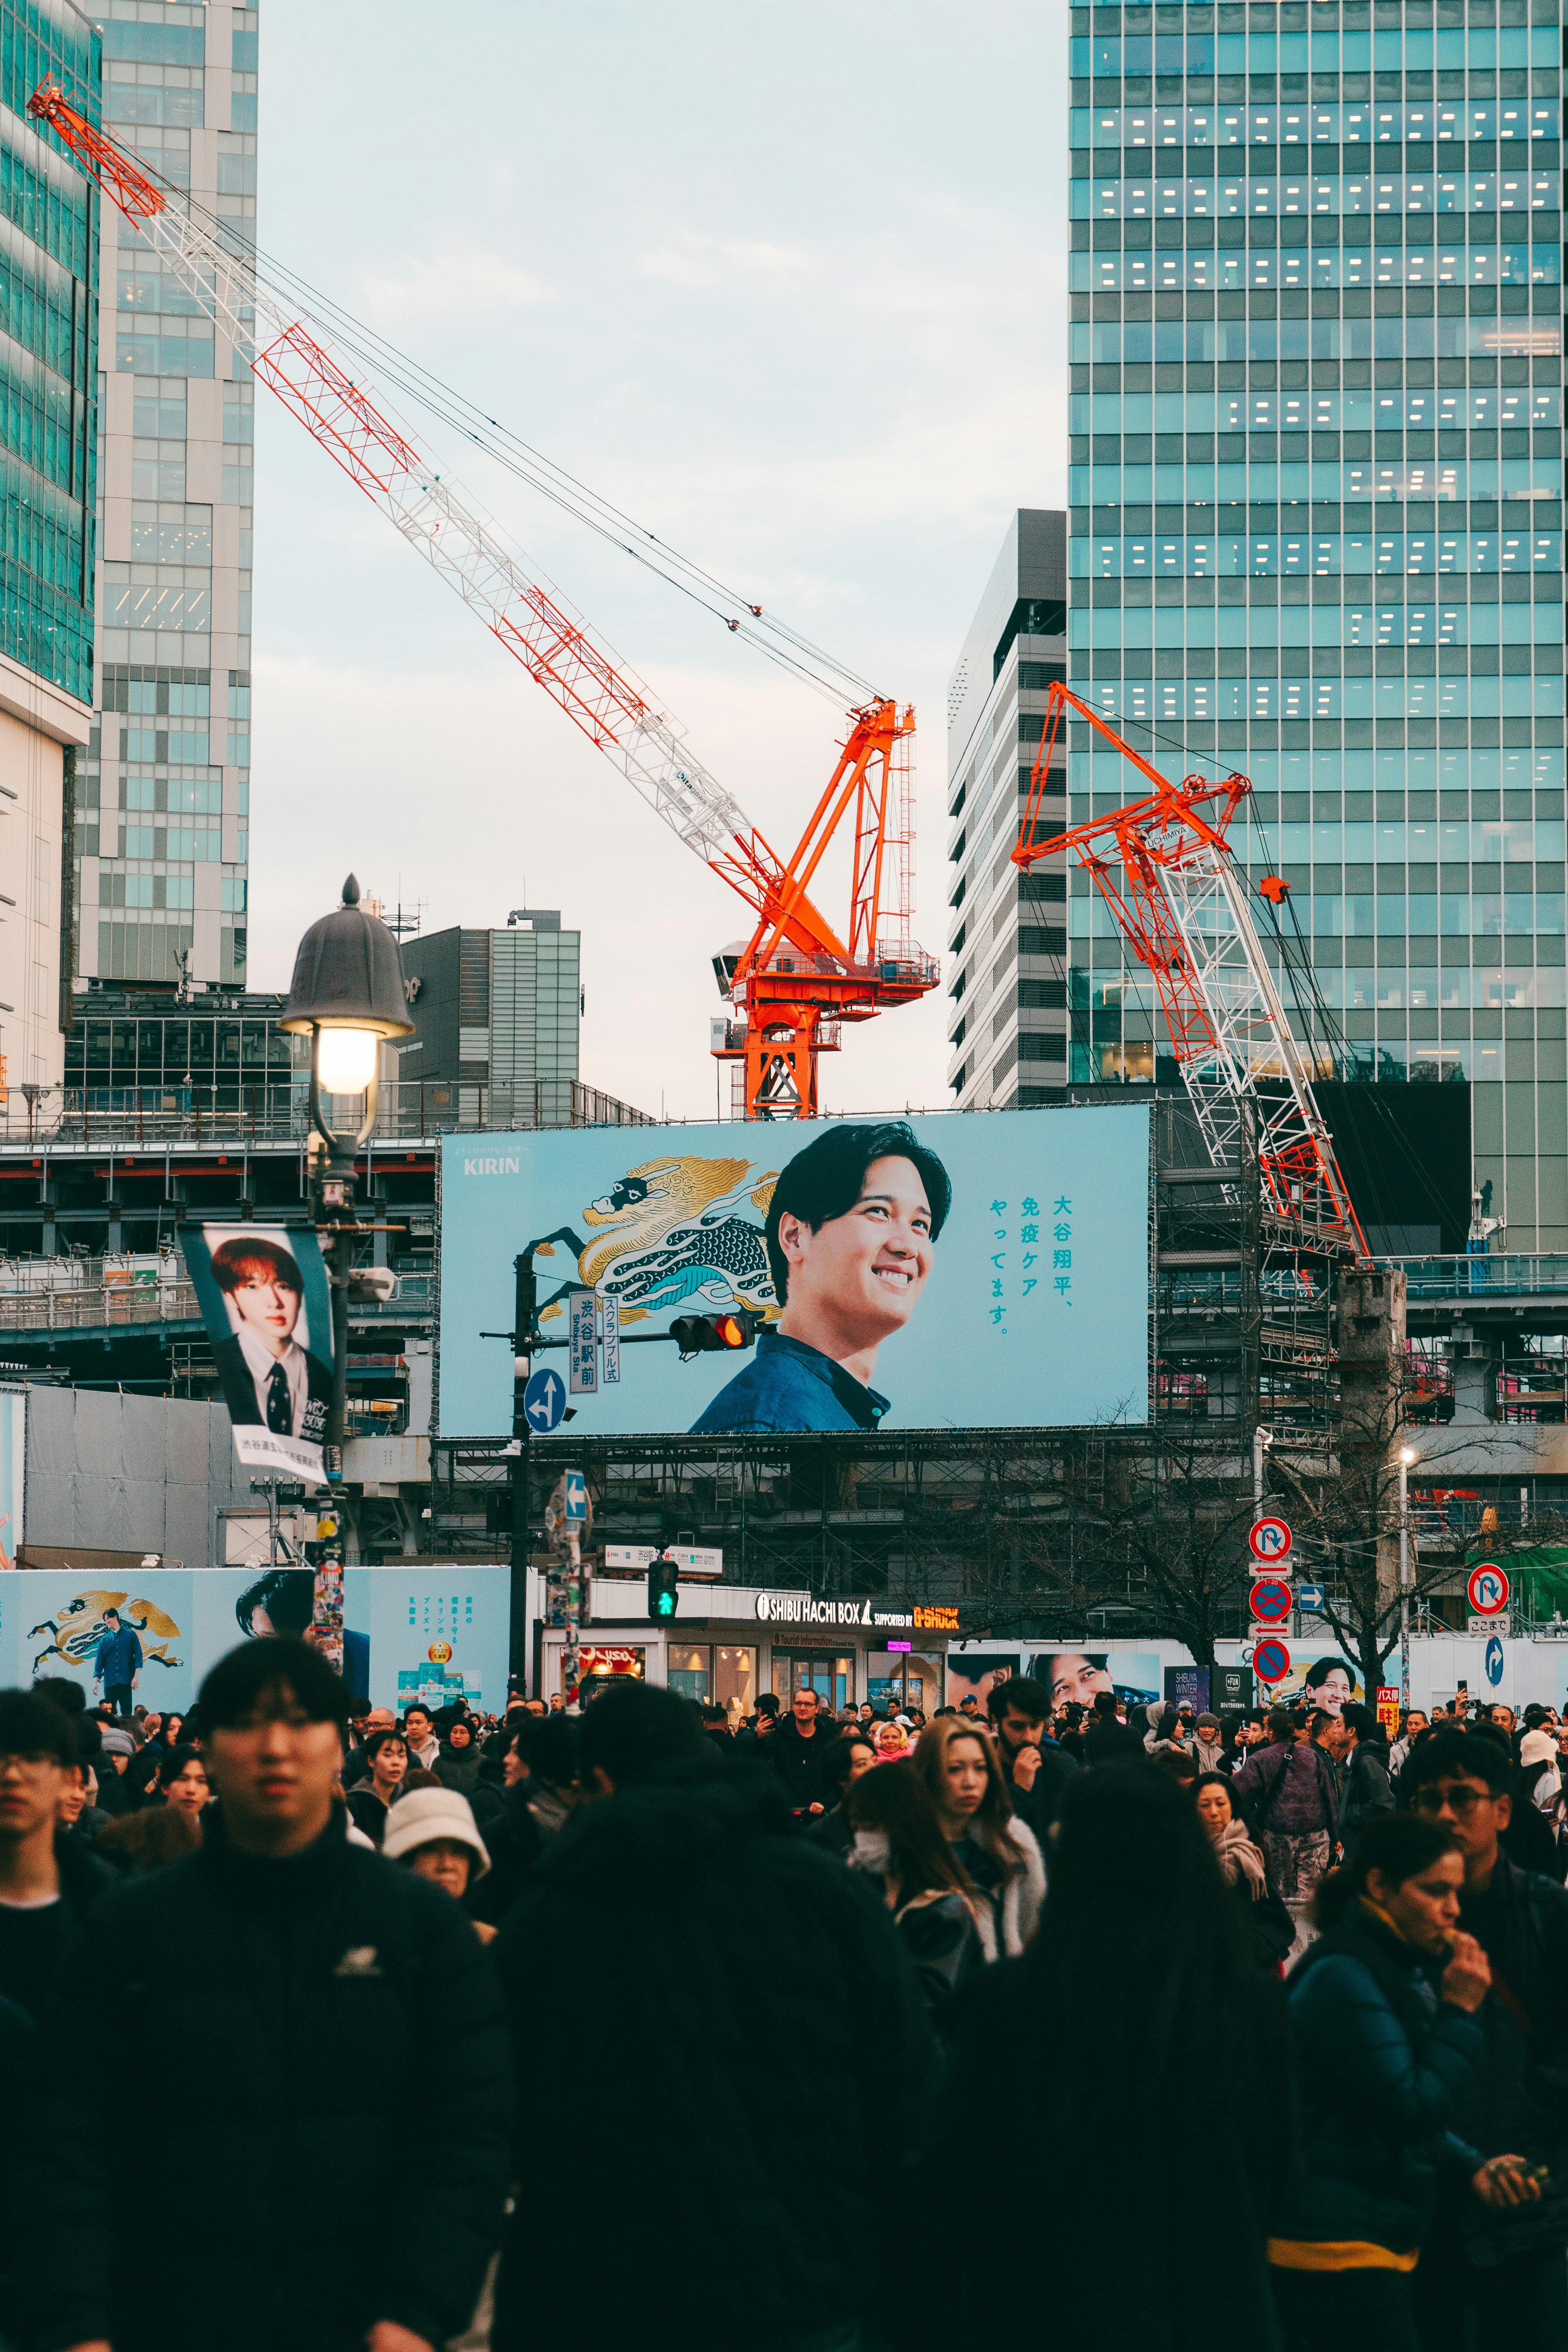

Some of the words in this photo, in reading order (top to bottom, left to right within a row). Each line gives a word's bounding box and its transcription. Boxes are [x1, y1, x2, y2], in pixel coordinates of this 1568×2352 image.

[1147, 826, 1187, 847] UCHIMIYA
[464, 1157, 520, 1176] KIRIN
[1021, 1197, 1040, 1296] 免疫ケア
[1053, 1196, 1072, 1307] 大谷翔平、
[989, 1200, 1007, 1334] やってます。
[581, 1300, 594, 1386] 渋谷駅前
[606, 1300, 616, 1380] スクランブル式
[770, 1598, 801, 1622] SHIBU
[802, 1601, 836, 1623] HACHI
[838, 1602, 860, 1624] BOX
[874, 1613, 905, 1626] SUPPORTED
[906, 1614, 913, 1627] BY
[914, 1605, 959, 1630] G-SHOCK
[1472, 1620, 1506, 1632] ここまで
[1176, 1673, 1197, 1683] SHIBUYA
[1176, 1683, 1198, 1694] WINTER
[1378, 1689, 1399, 1702] バス停
